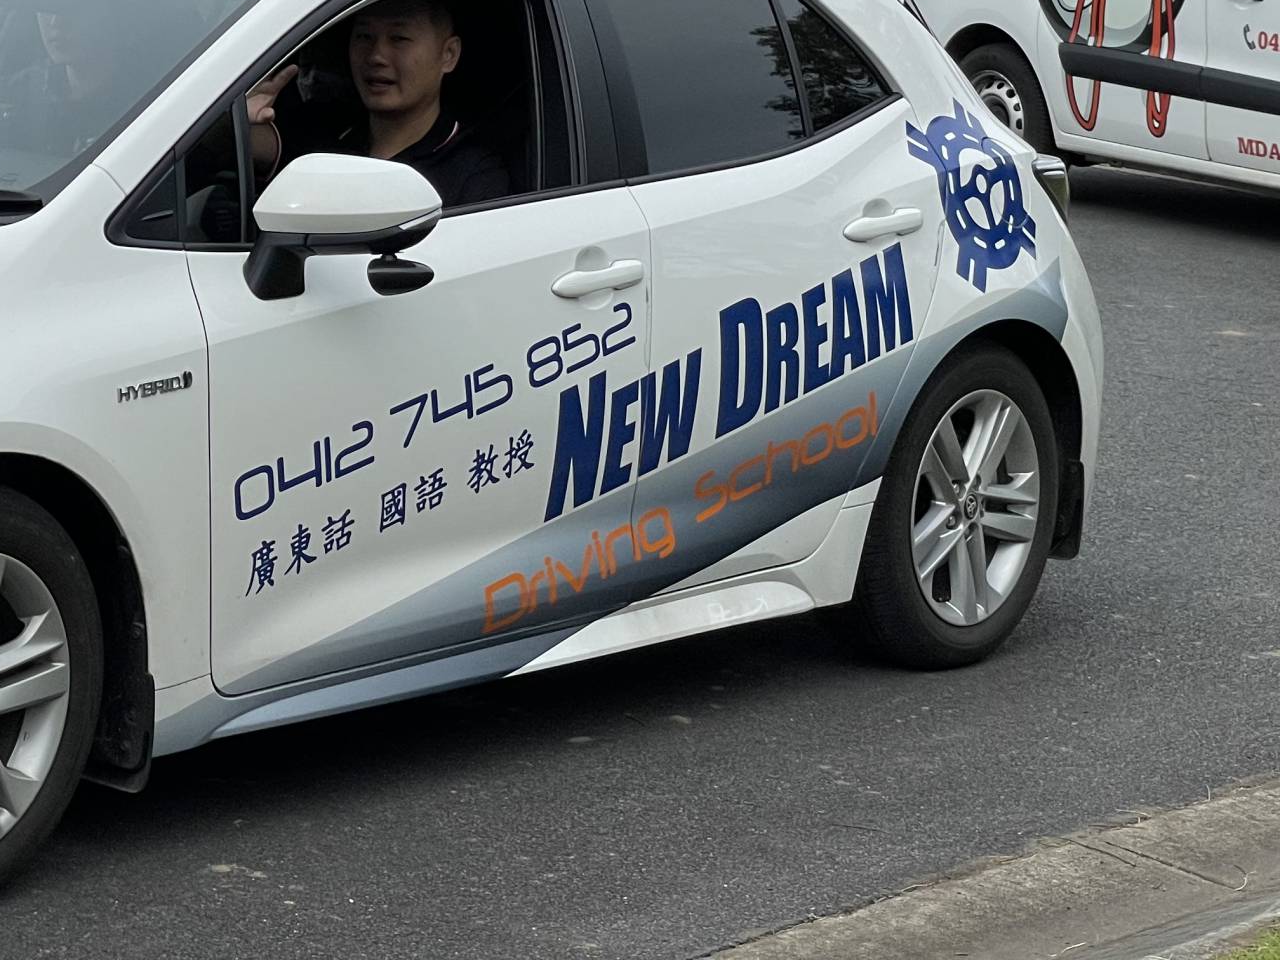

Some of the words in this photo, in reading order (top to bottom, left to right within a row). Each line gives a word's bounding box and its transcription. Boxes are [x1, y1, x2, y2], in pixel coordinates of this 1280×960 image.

[117, 375, 181, 403] HYBRID
[234, 420, 375, 521] 0412
[390, 363, 514, 448] 745
[526, 302, 637, 388] 852
[245, 509, 355, 598] 廣東話
[379, 468, 448, 533] 國語
[466, 429, 536, 495] 教授
[482, 506, 675, 635] Driving
[694, 390, 877, 523] School
